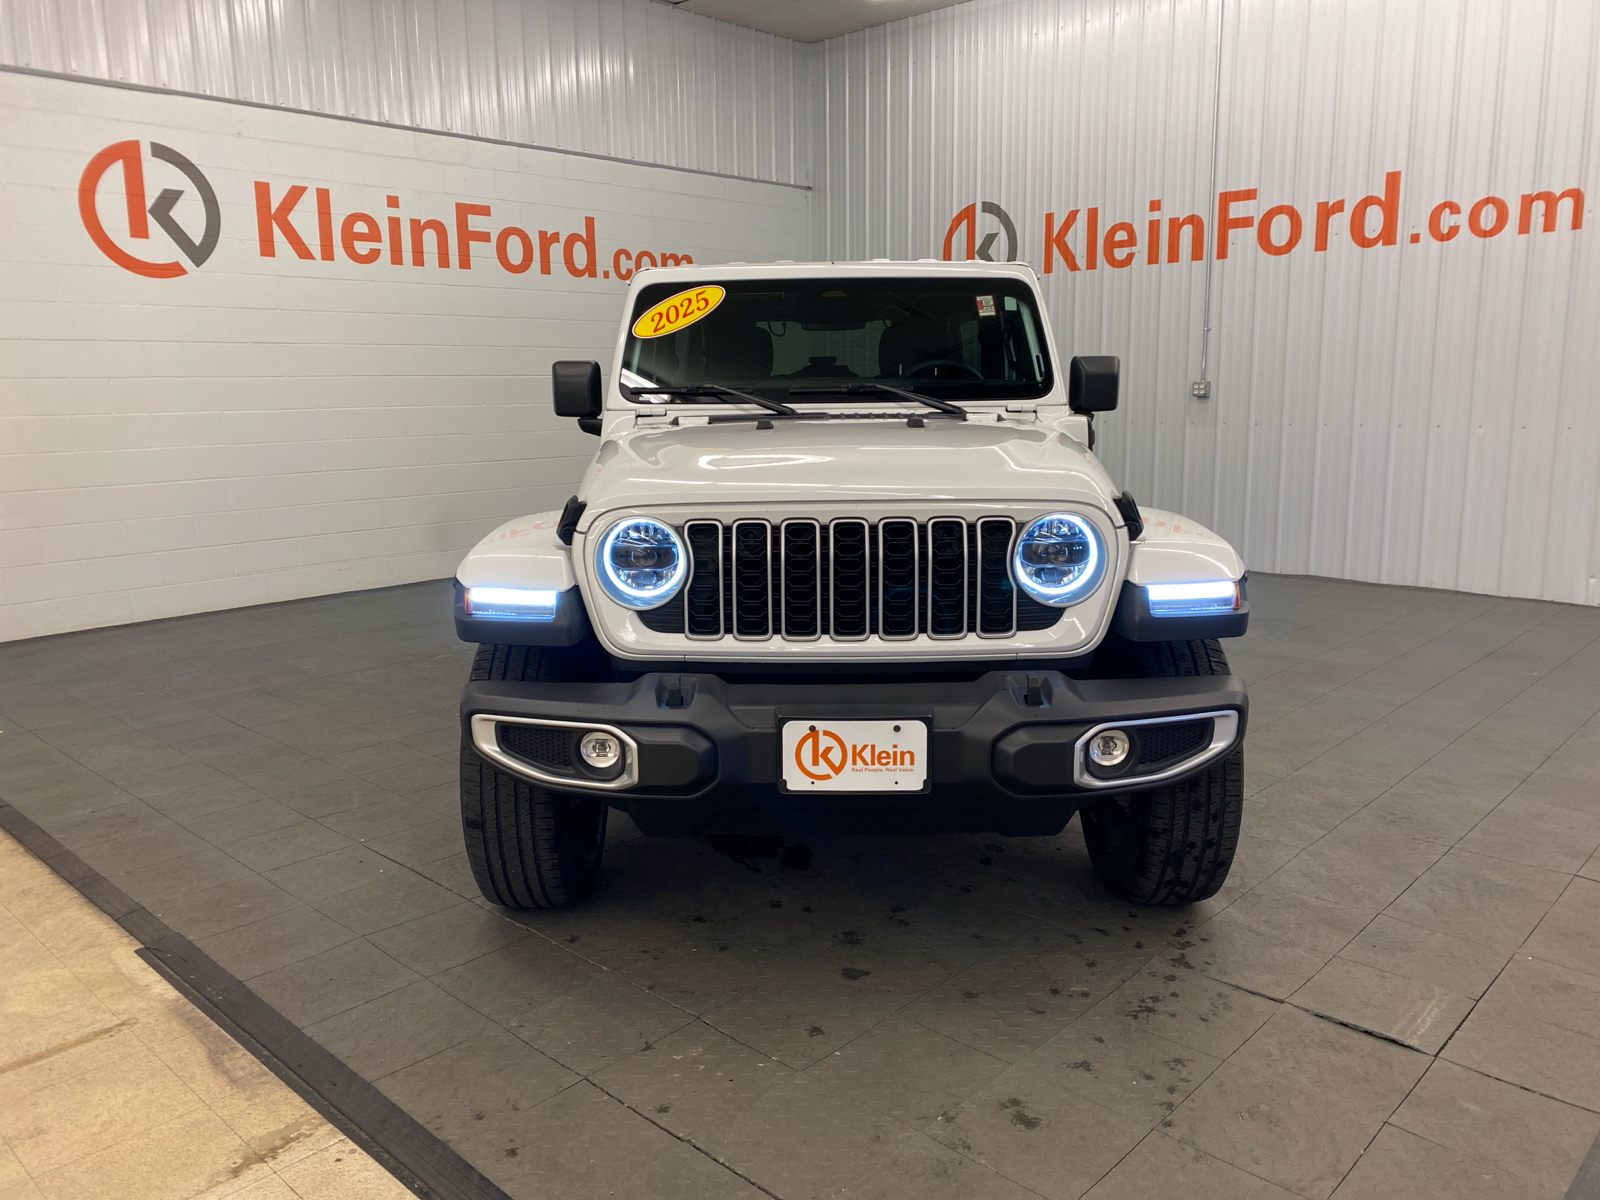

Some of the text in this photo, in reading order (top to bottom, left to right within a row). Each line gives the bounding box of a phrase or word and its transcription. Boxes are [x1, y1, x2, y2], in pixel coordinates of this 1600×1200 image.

[1043, 170, 1585, 274] KleinFord.com
[650, 289, 709, 333] 2025
[851, 743, 915, 766] Klein
